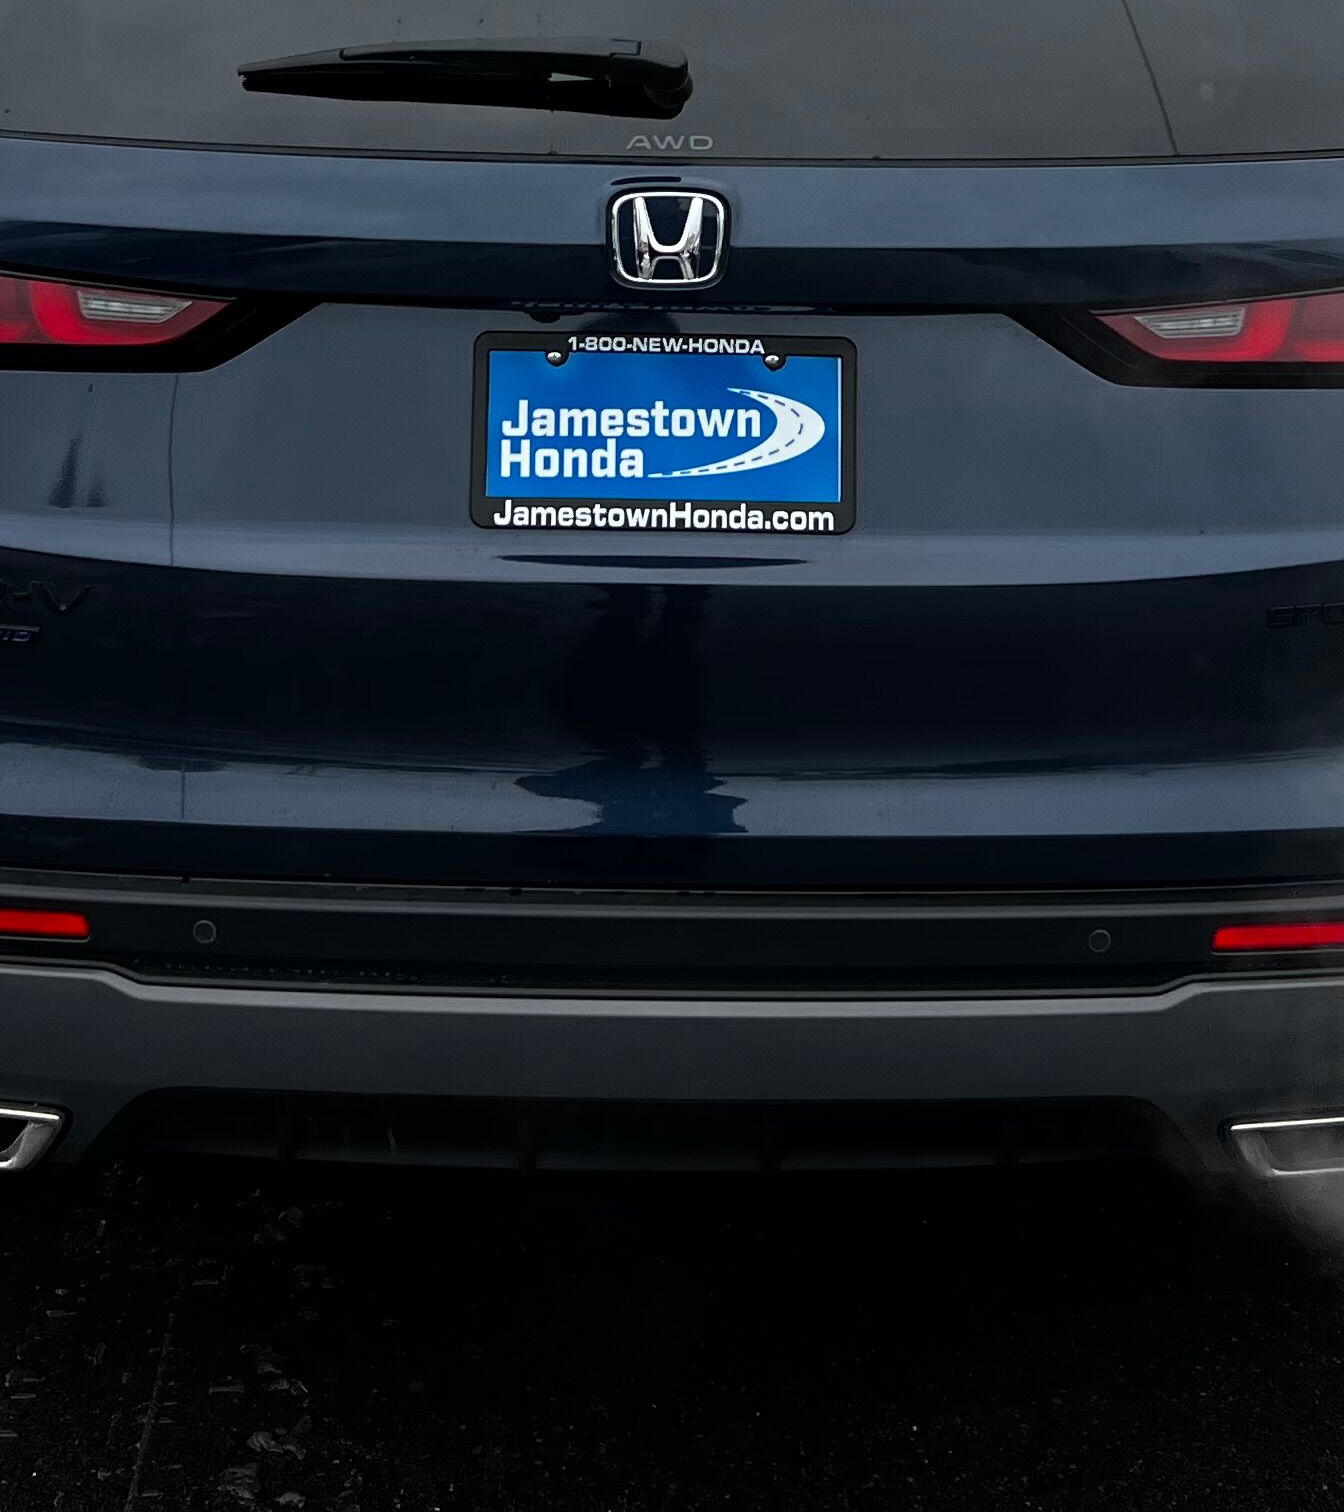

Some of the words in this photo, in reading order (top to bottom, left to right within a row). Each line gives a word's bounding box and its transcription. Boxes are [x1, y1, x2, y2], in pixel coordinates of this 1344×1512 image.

[625, 134, 715, 151] AWD
[567, 336, 765, 355] 1-800-NEW-HONDA
[501, 399, 761, 438] Jamestown
[500, 439, 644, 478] Honda
[493, 499, 835, 532] JamestownHonda.com
